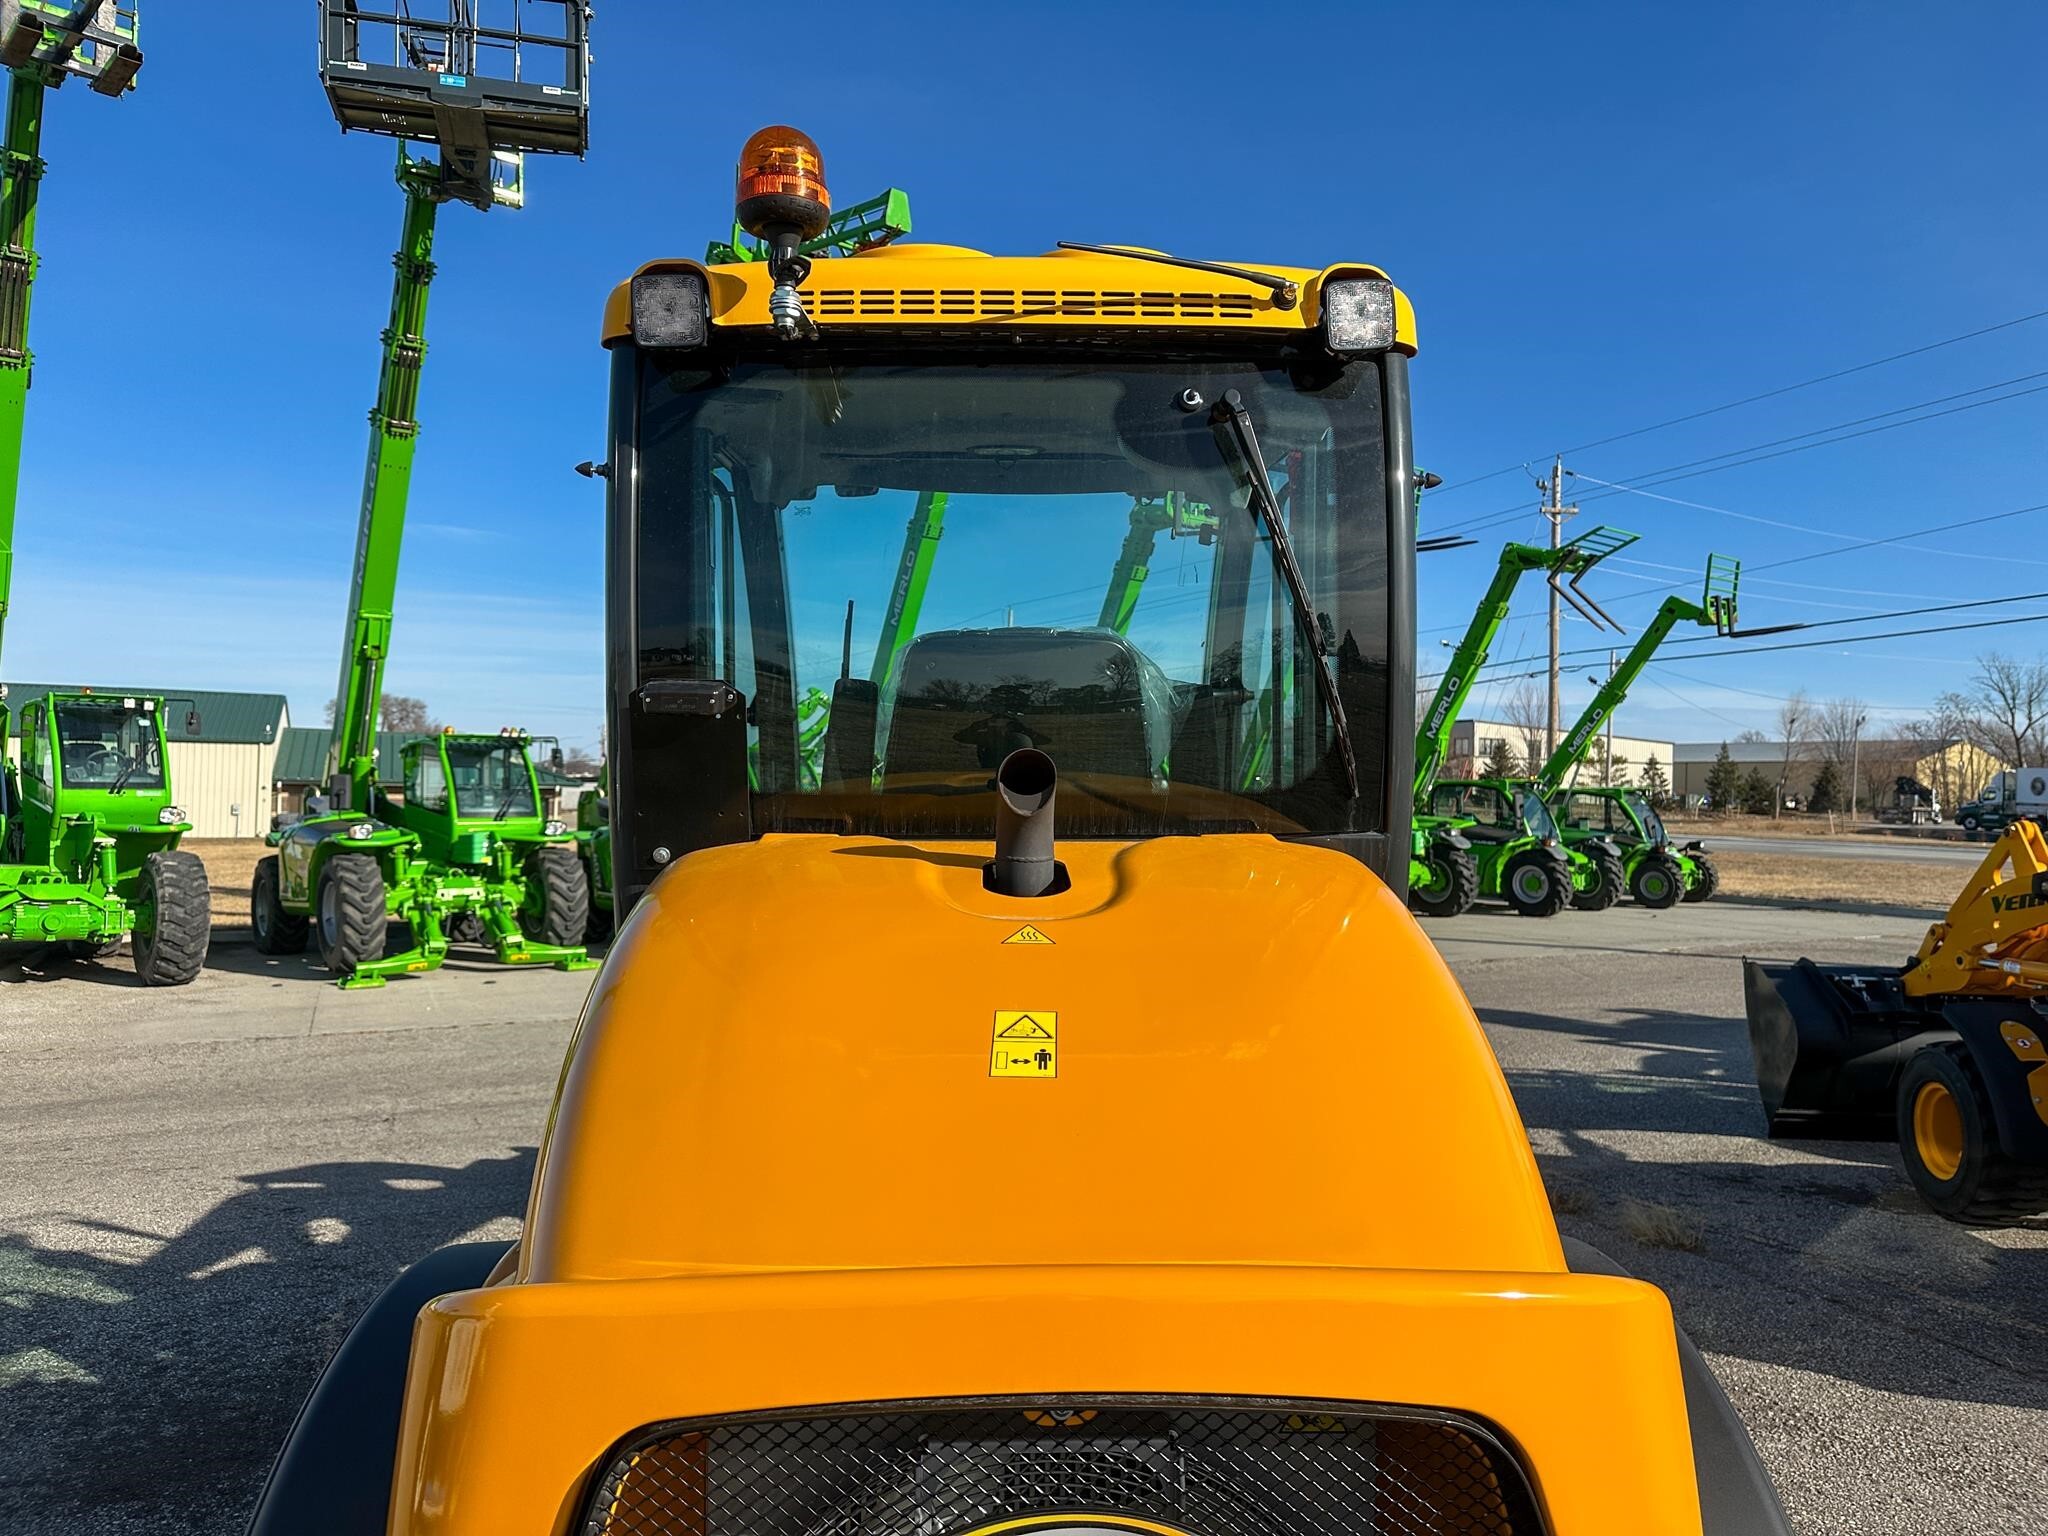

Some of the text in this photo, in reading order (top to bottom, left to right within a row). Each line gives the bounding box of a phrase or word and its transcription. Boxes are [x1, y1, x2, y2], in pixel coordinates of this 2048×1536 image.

[890, 550, 916, 626] MERLO
[1426, 676, 1460, 739] MERLO
[1568, 708, 1603, 754] MERLO
